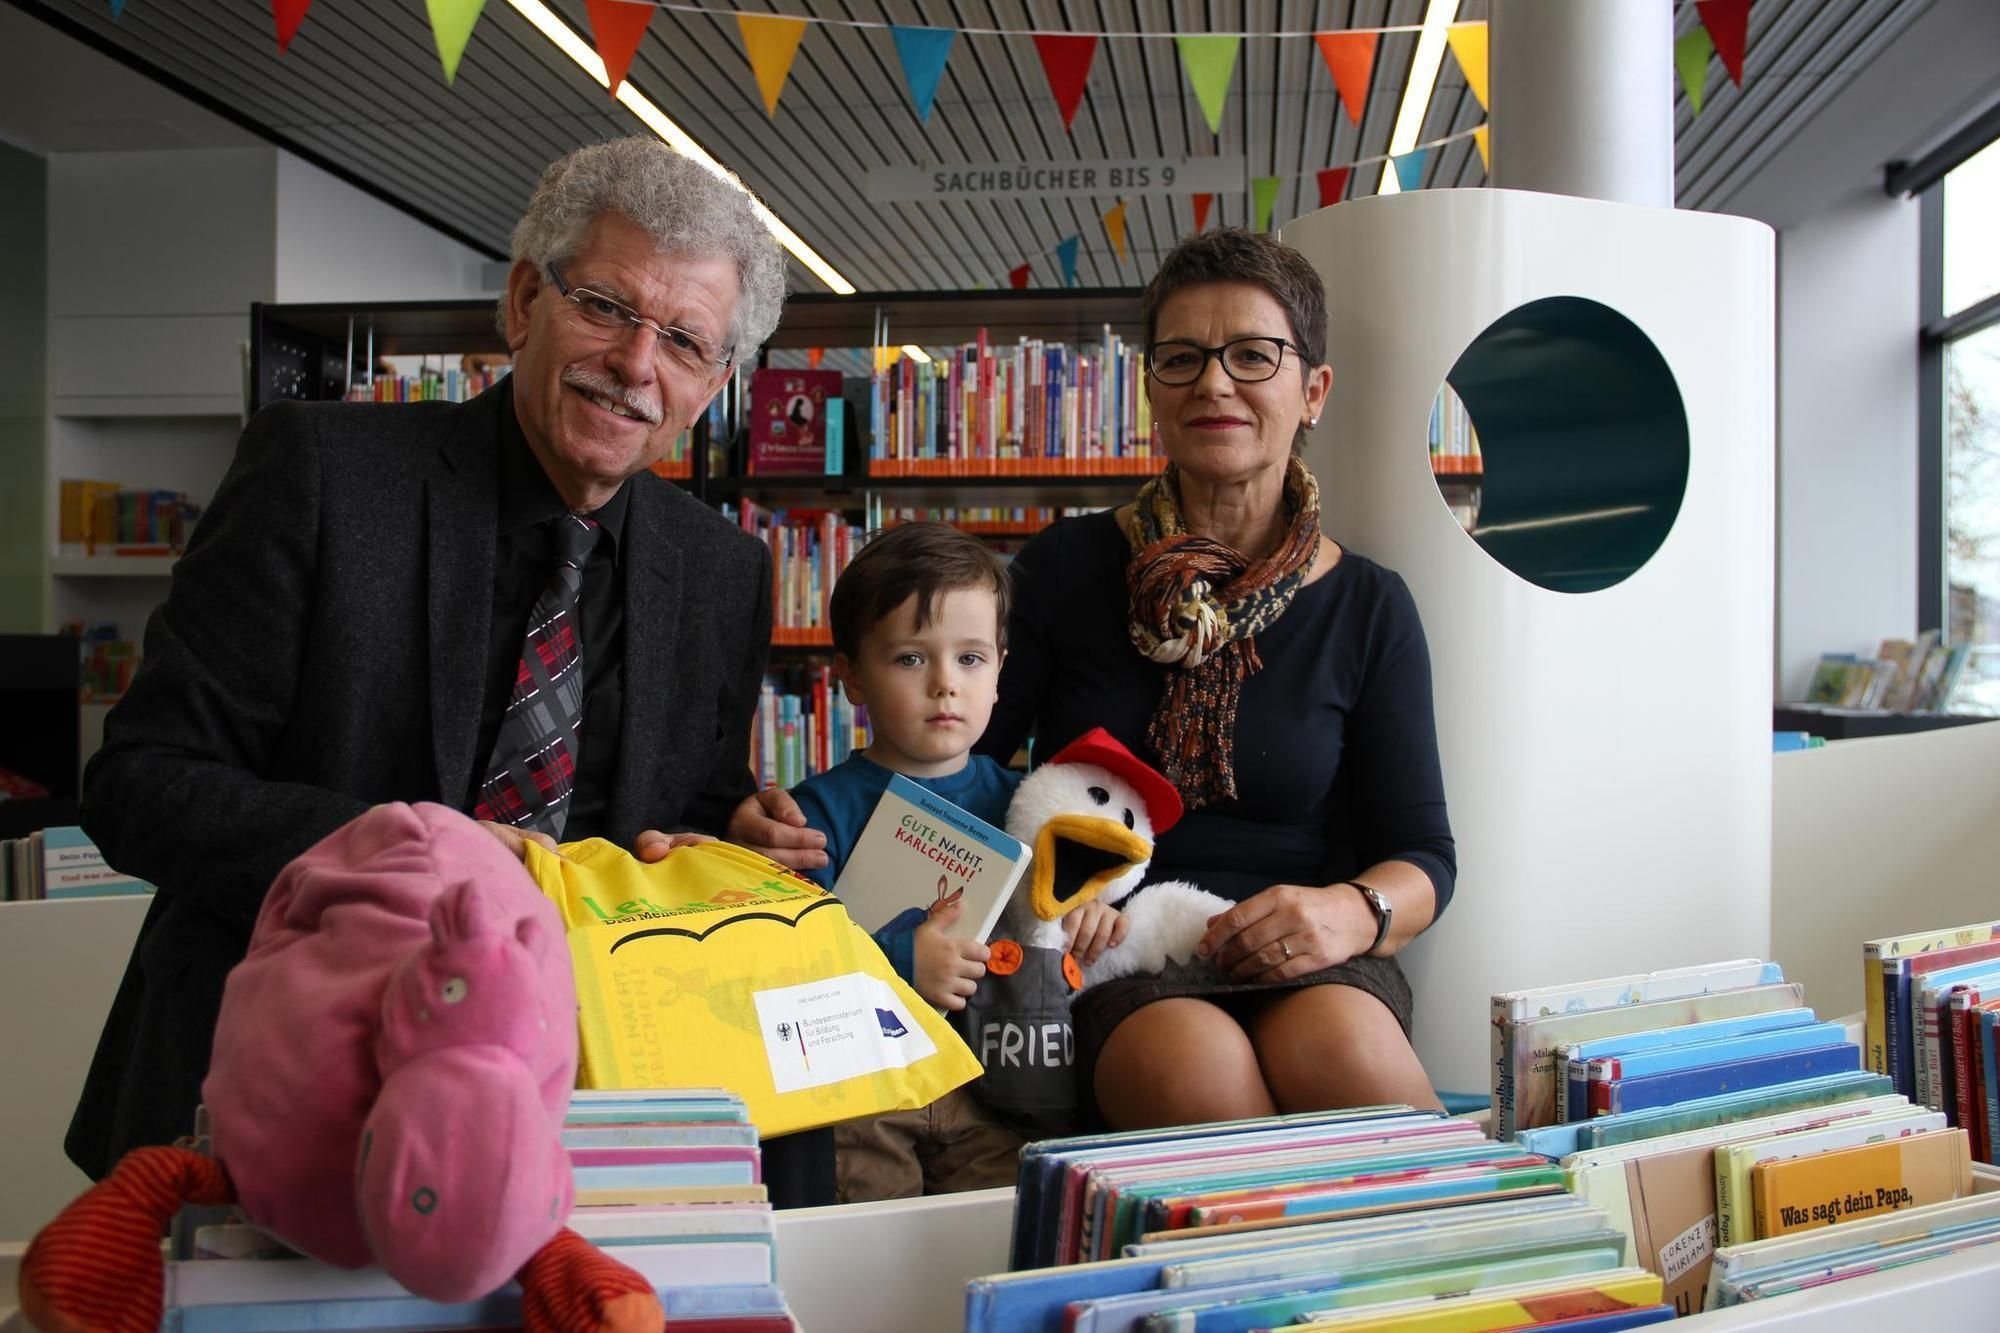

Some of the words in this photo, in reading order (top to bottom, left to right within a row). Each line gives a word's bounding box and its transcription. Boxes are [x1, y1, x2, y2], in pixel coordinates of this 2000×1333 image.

[933, 166, 1097, 192] SACHBÜCHER
[1109, 167, 1150, 188] BIS
[1162, 167, 1176, 187] 9
[895, 827, 976, 883] KARLCHEN!
[901, 814, 938, 843] GUTE
[938, 836, 983, 873] NACHT,
[802, 1008, 863, 1028] Bundesministerium
[815, 1024, 841, 1036] Bildung
[1953, 1014, 1962, 1044] U-Boot
[820, 1030, 854, 1045] Forschung
[1956, 1060, 1967, 1104] Abenteuer
[1719, 1174, 1729, 1209] Janosch
[1780, 1205, 1808, 1228] Was
[1812, 1199, 1841, 1224] sagt
[1844, 1191, 1874, 1213] dein
[1876, 1187, 1913, 1209] Papa,
[1663, 1227, 1701, 1262] LORENZ
[1720, 1215, 1730, 1242] Papa
[1667, 1242, 1705, 1279] MIRIAM
